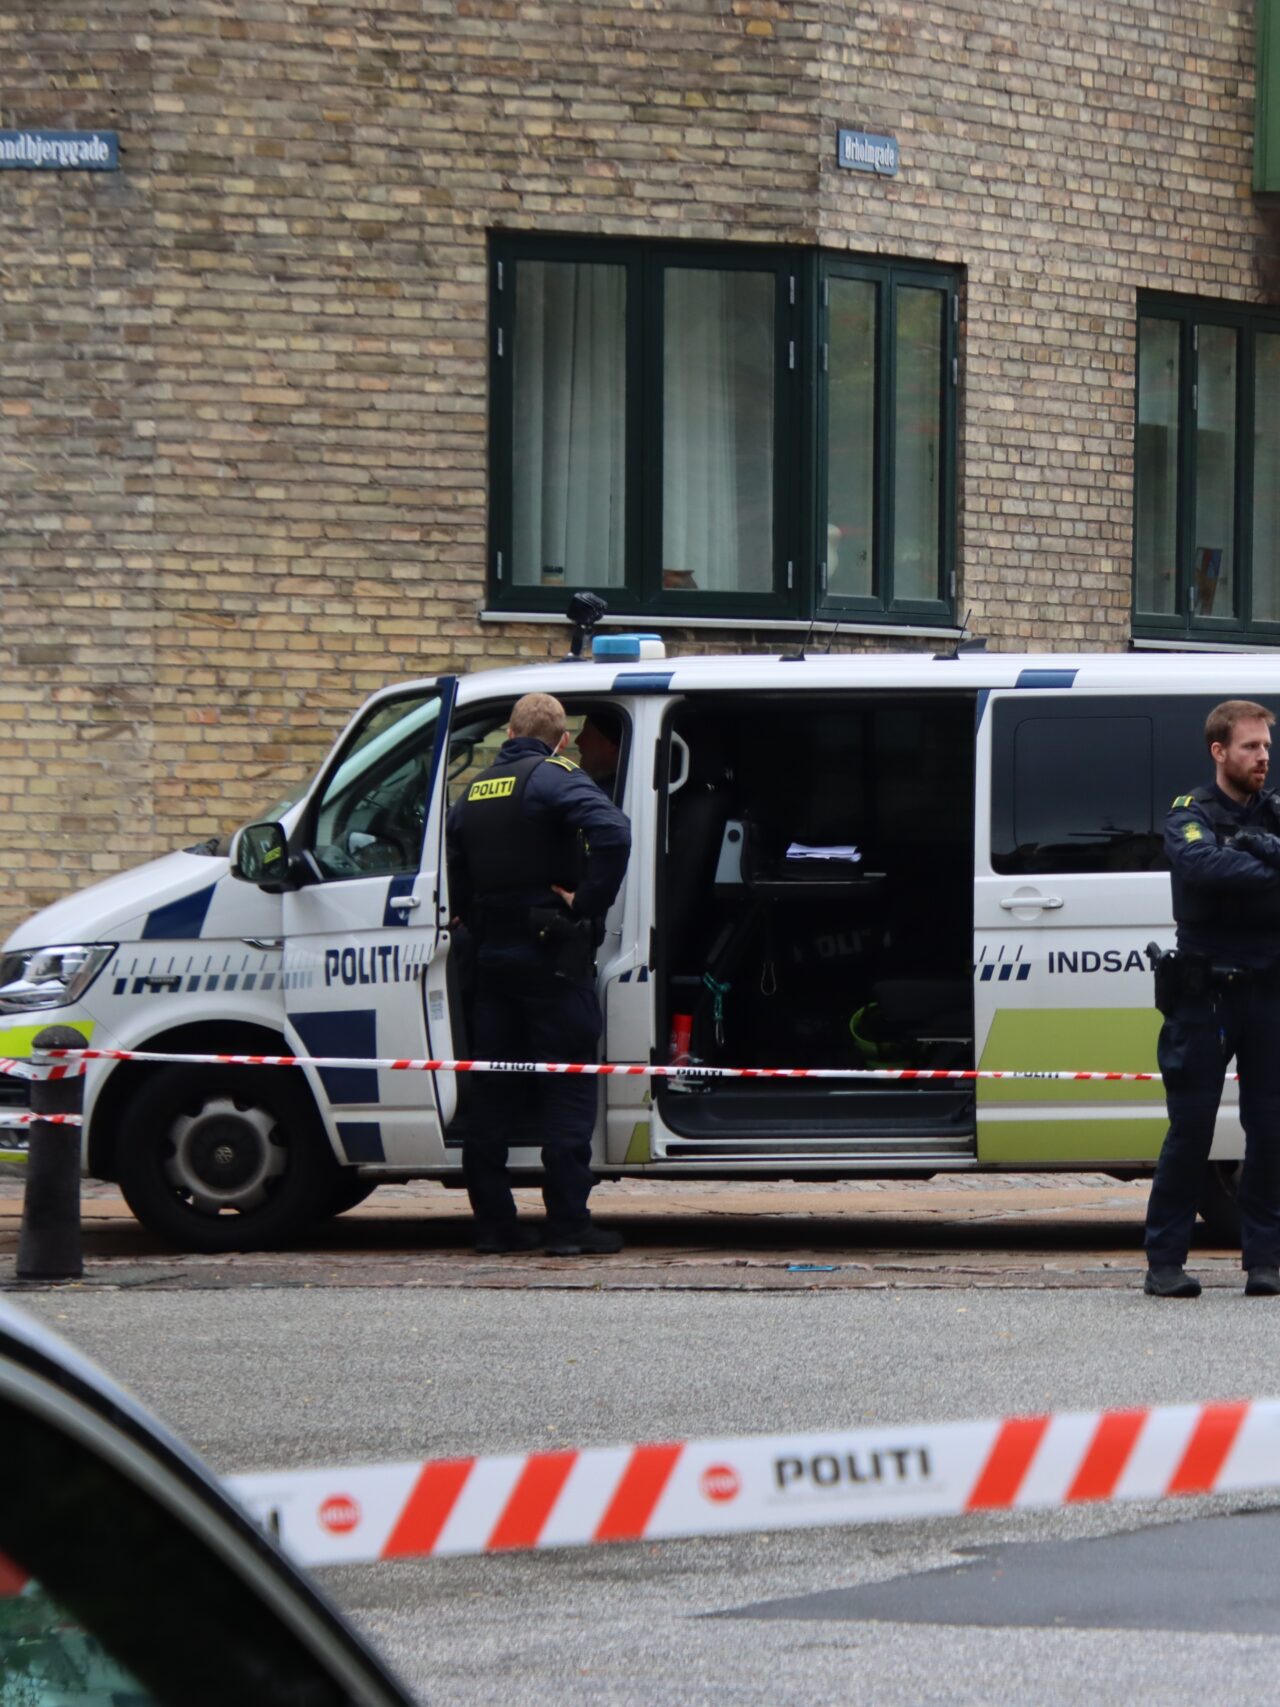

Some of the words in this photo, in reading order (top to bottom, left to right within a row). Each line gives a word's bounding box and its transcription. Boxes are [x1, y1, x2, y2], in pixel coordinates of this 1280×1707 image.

[845, 135, 895, 171] Ørholmgade
[469, 780, 514, 798] POLITI
[324, 944, 400, 987] POLITI
[774, 1445, 931, 1489] POLITI
